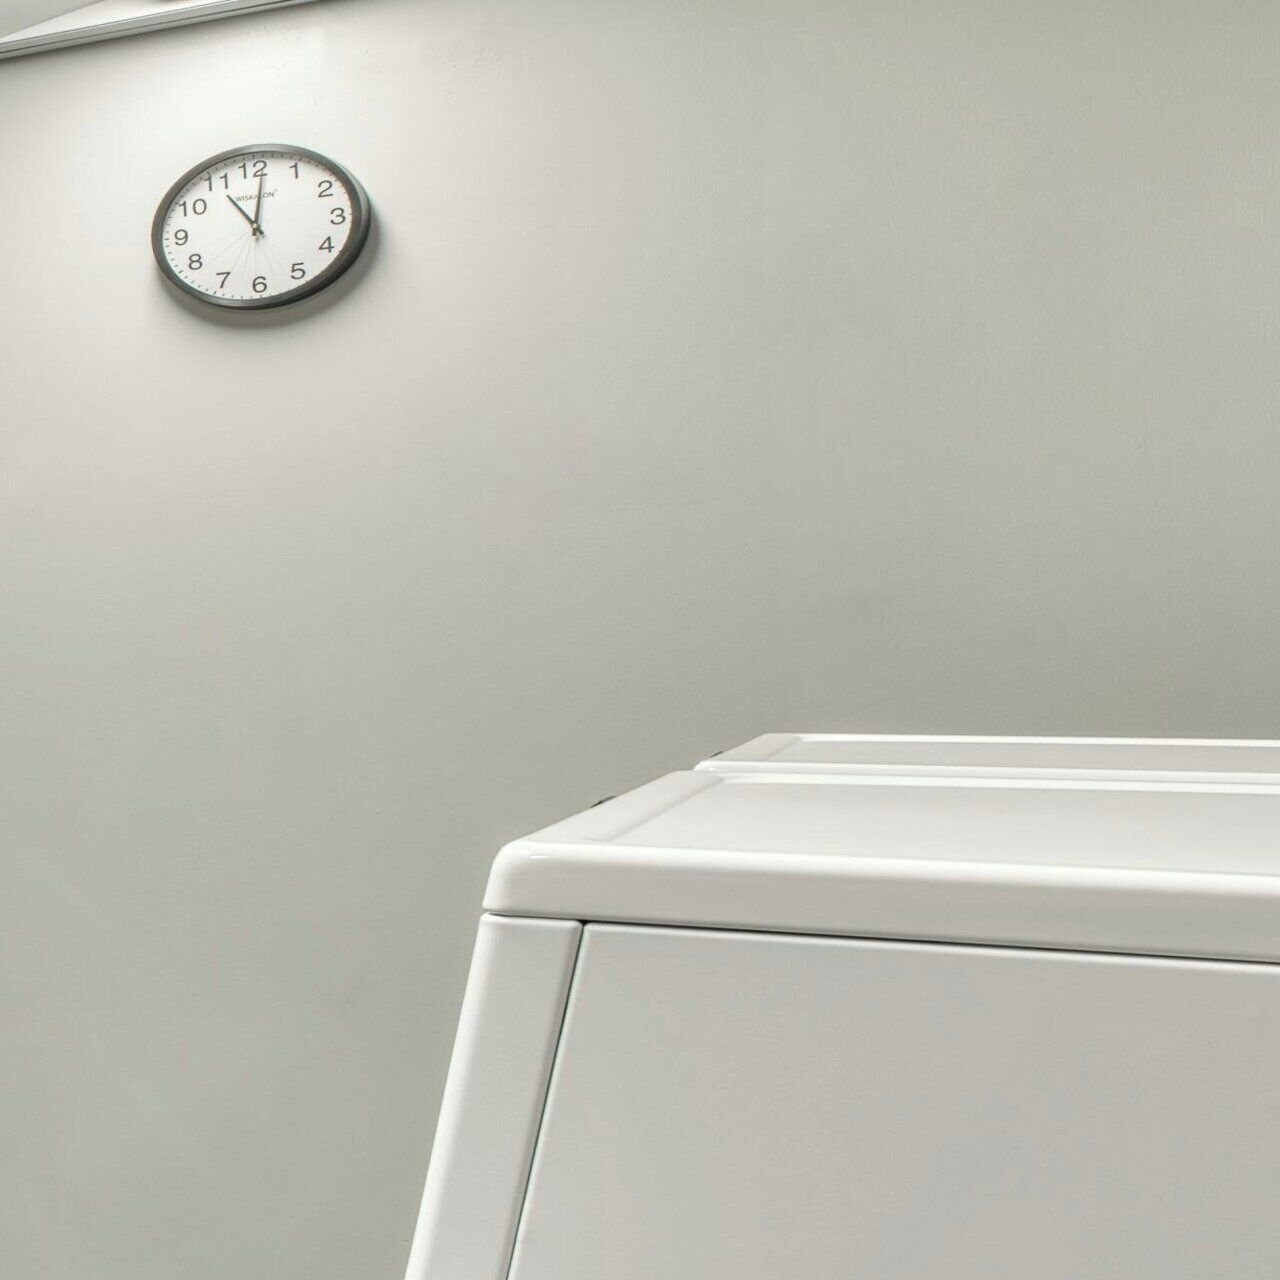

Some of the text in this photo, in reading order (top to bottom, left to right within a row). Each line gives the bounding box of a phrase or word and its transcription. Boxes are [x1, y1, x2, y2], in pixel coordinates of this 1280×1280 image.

[238, 160, 268, 179] 12
[289, 162, 299, 179] 1
[203, 173, 229, 191] 11
[318, 180, 334, 198] 2
[178, 198, 207, 217] 10
[330, 207, 346, 225] 3
[174, 229, 188, 246] 9
[318, 236, 335, 253] 4
[188, 253, 203, 270] 8
[216, 271, 231, 289] 7
[290, 262, 306, 280] 5
[252, 276, 268, 293] 6
